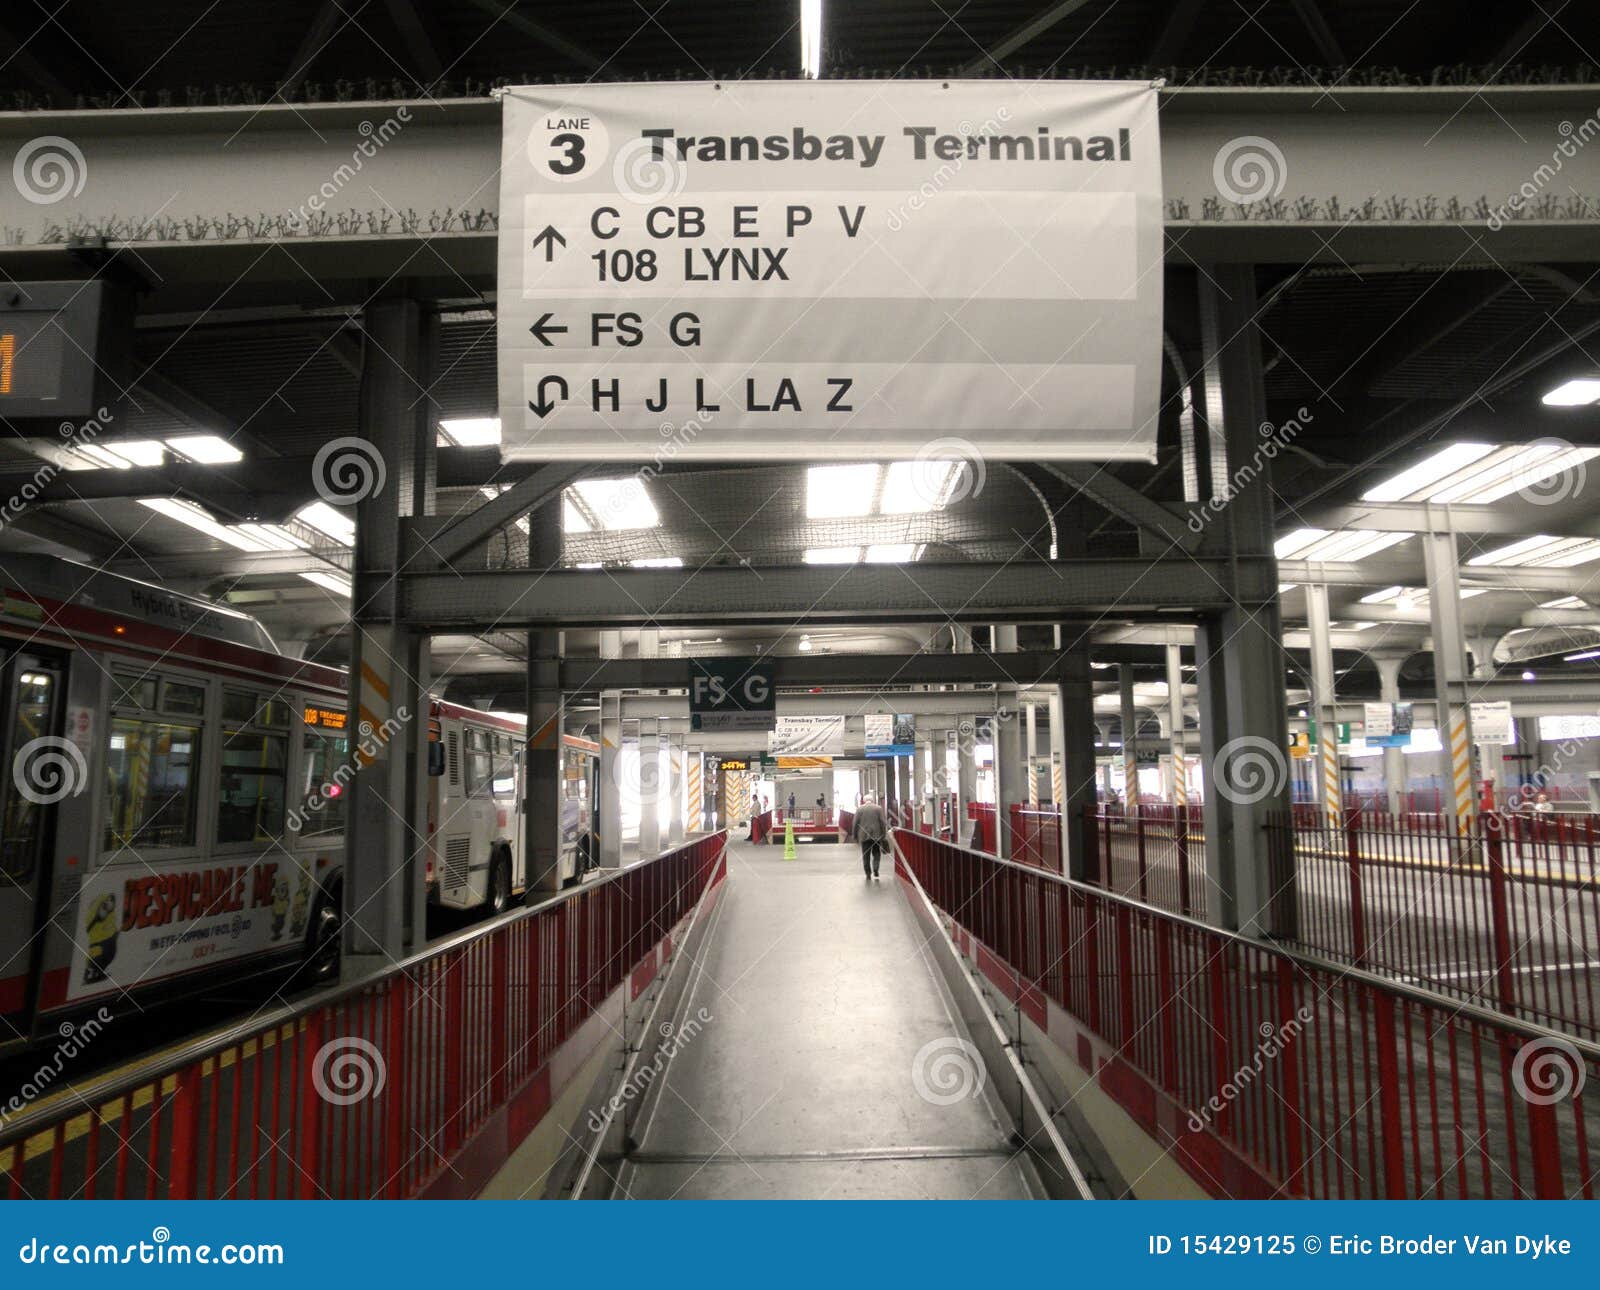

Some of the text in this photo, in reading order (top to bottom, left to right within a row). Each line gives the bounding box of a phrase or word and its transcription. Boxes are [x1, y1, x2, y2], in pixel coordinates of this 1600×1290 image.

[548, 118, 589, 130] LANE
[549, 134, 585, 175] 3
[642, 127, 1130, 168] Transbay Terminal
[591, 205, 866, 239] C CB E P V
[591, 248, 790, 282] 108 LYNX
[591, 312, 701, 346] FS G
[591, 378, 853, 413] H J L LA Z
[694, 675, 769, 704] FS G
[121, 865, 247, 932] DESPICABLE
